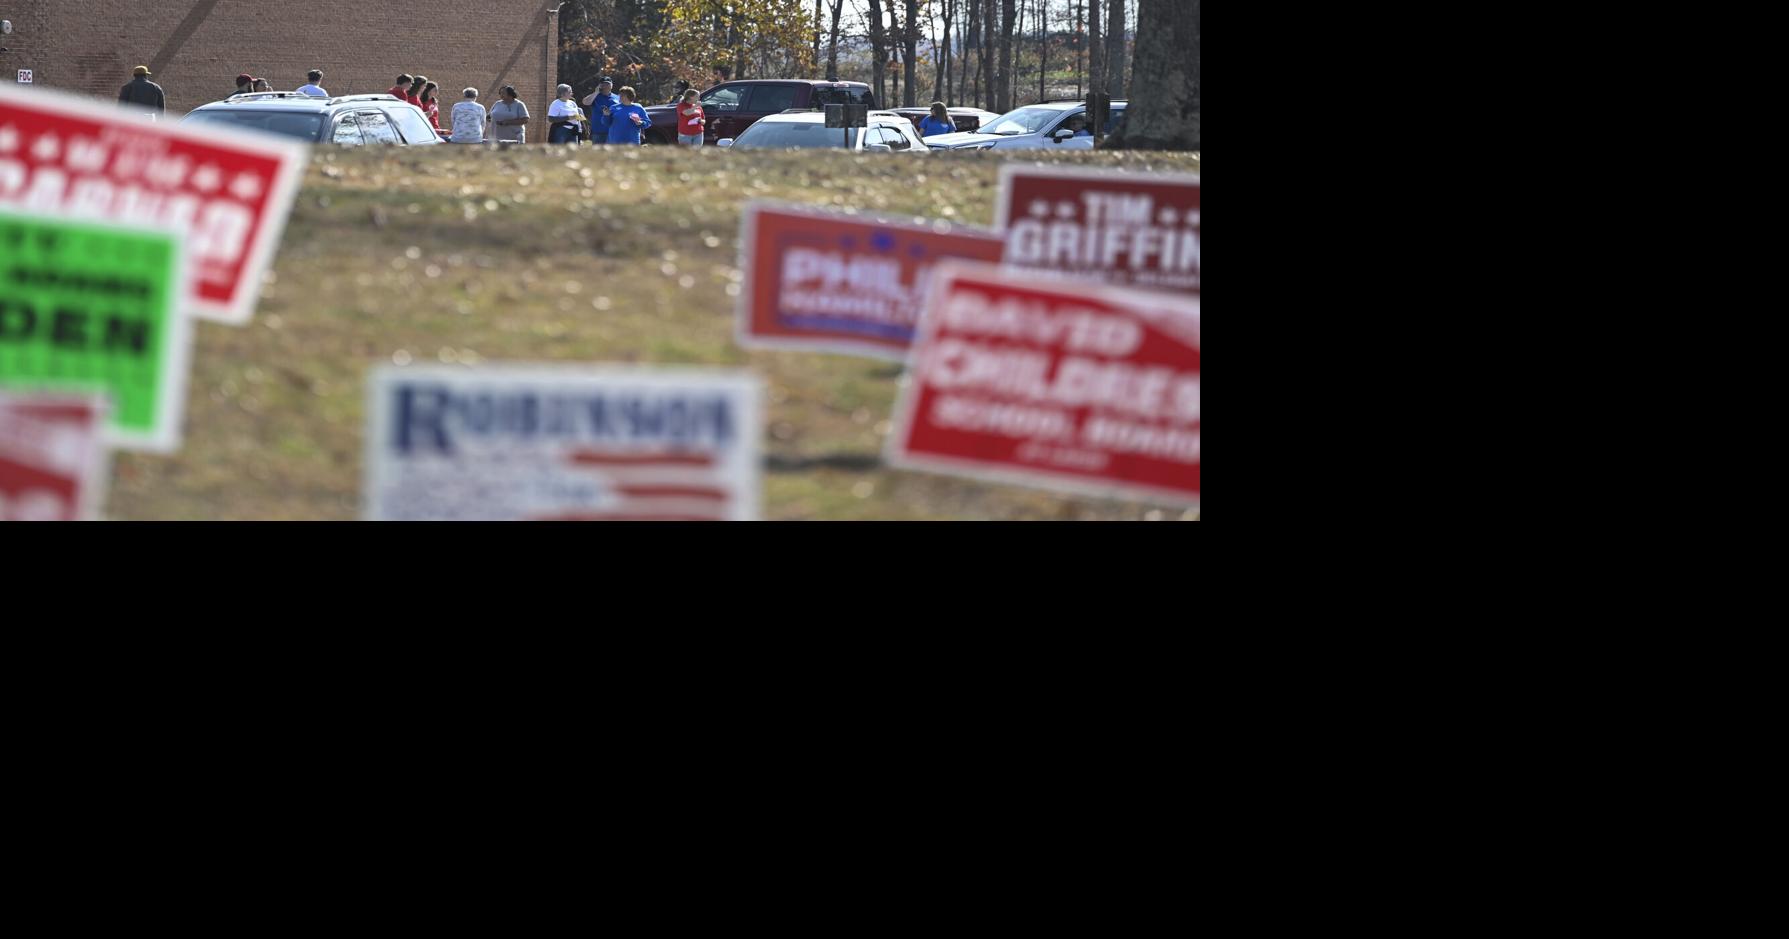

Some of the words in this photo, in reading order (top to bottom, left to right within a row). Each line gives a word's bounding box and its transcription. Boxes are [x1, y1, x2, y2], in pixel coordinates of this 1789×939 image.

[19, 71, 32, 81] FDC
[1083, 191, 1152, 223] TIM
[1008, 219, 1200, 272] GRIFFIN
[944, 291, 1142, 356] DAVID
[392, 380, 732, 453] ROBINSON
[930, 393, 1072, 440] SCHOOL
